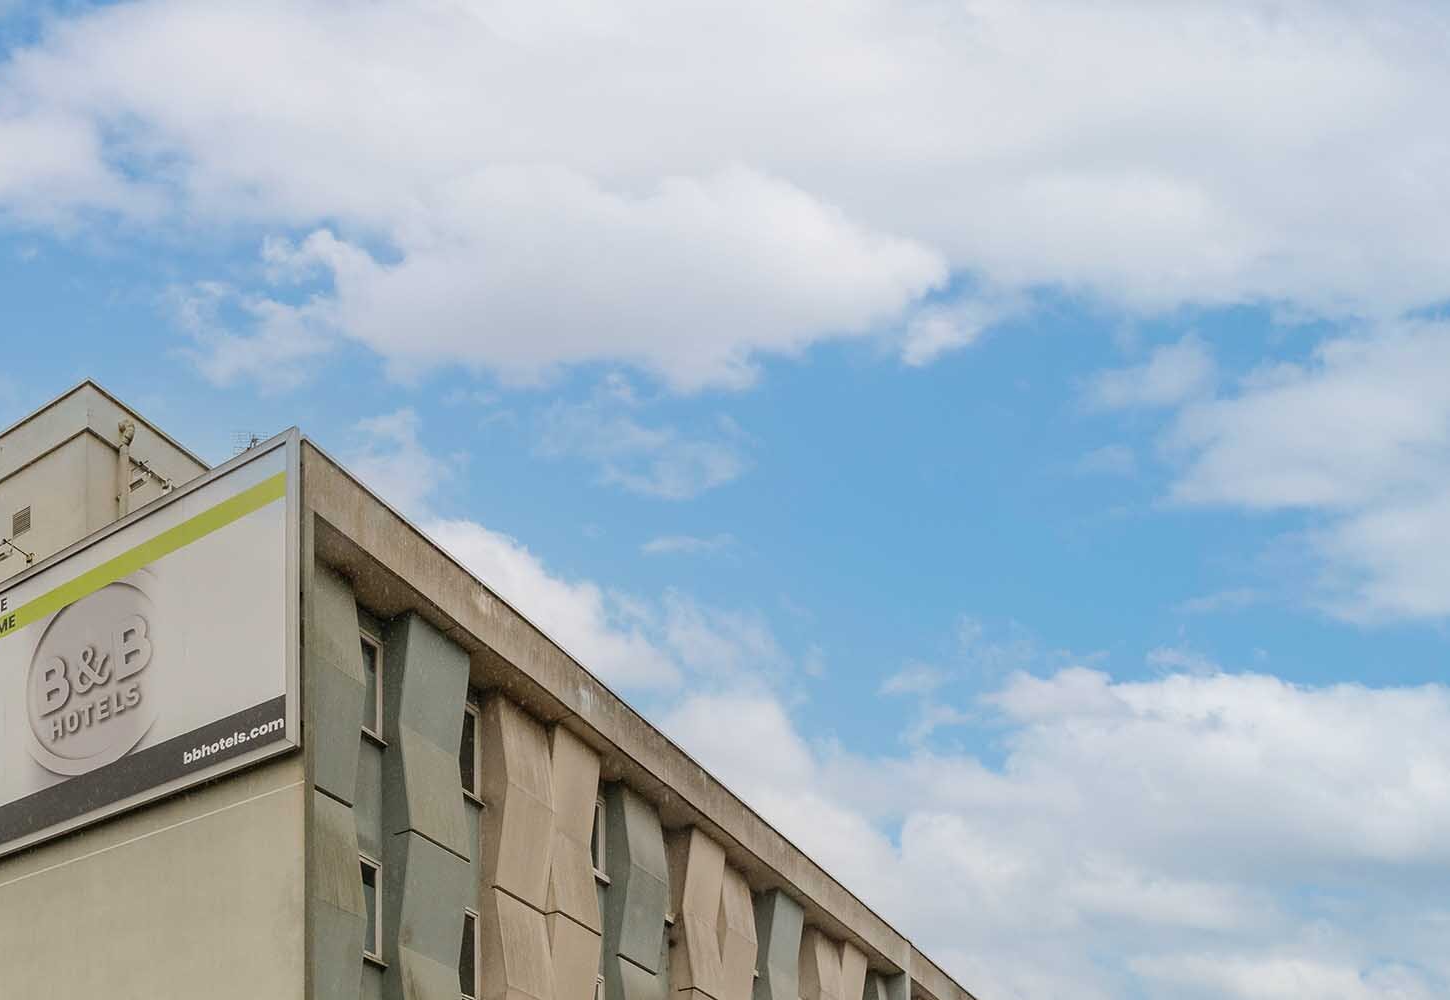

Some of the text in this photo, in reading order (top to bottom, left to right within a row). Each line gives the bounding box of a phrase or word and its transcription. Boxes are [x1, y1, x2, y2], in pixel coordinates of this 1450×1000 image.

[37, 613, 152, 718] B&B
[51, 684, 141, 741] HOTELS
[183, 718, 284, 764] bbhotels.com
